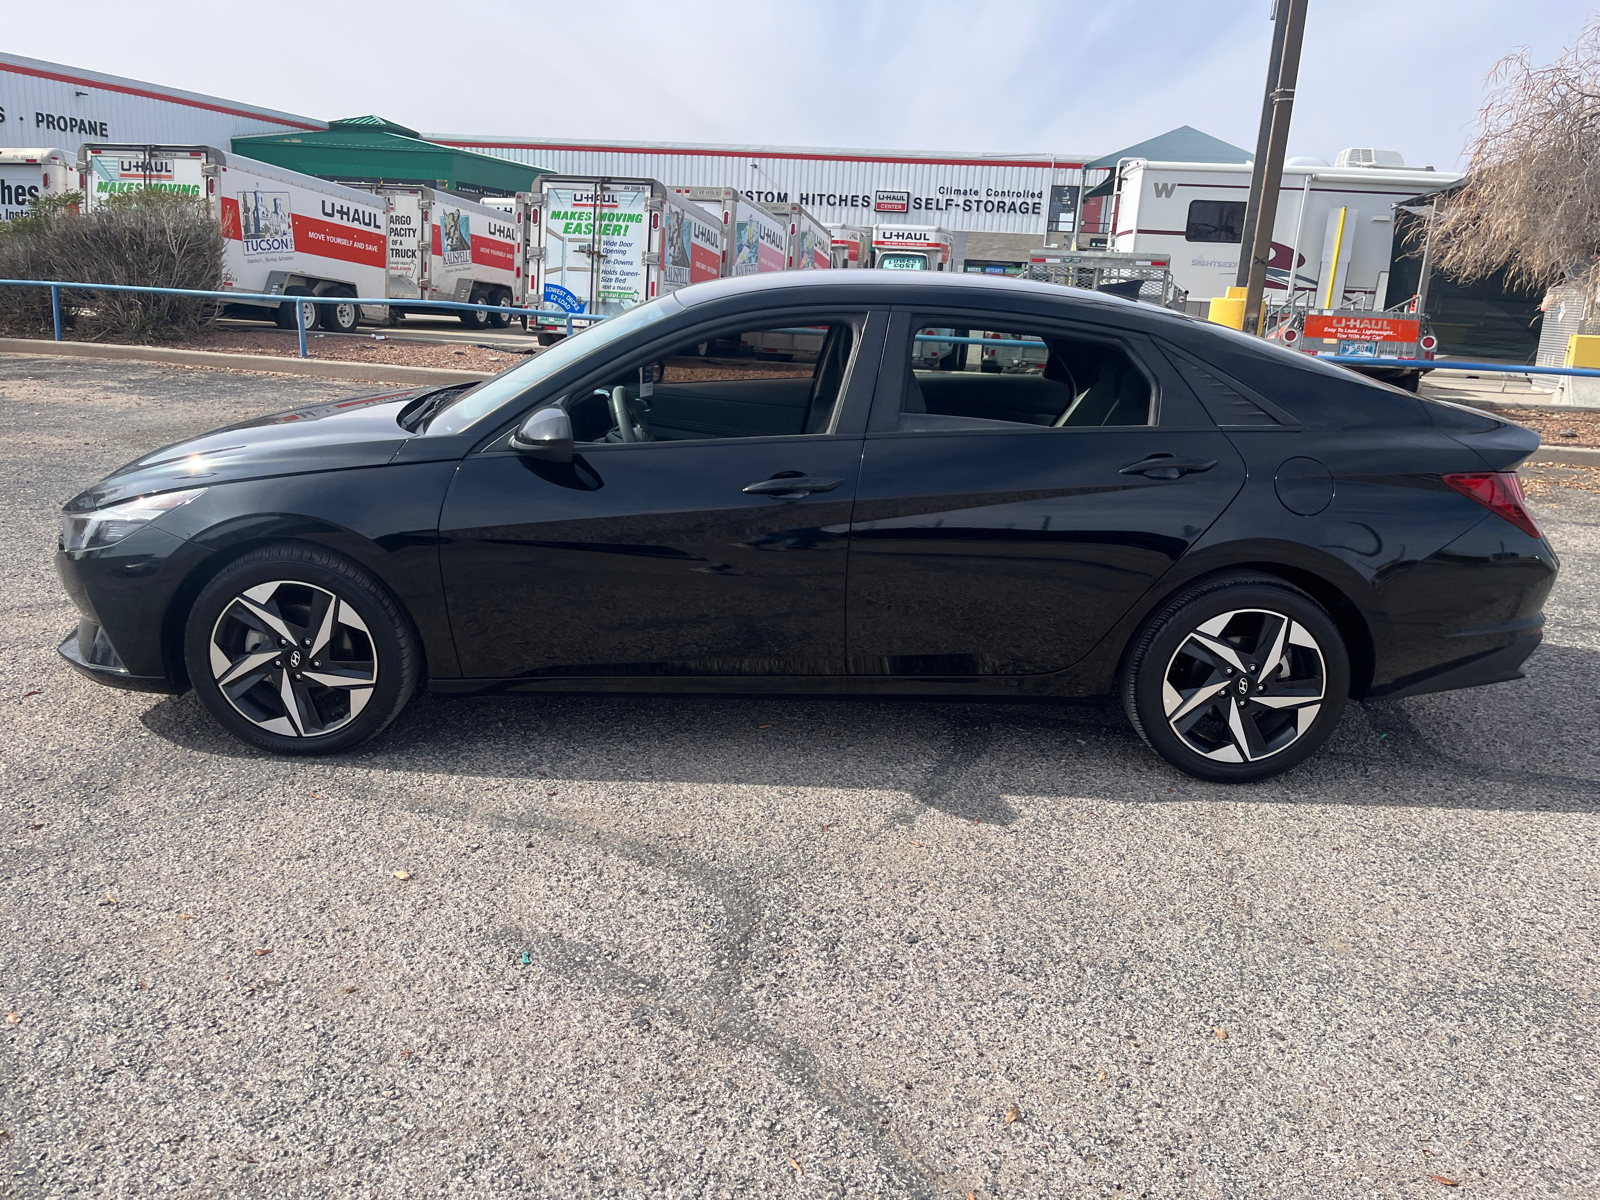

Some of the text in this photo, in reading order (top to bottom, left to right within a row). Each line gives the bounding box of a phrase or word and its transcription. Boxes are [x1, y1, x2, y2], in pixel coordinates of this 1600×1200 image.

[35, 111, 108, 138] PROPANE
[121, 160, 172, 173] U-HAUL
[96, 181, 143, 193] MAKES
[938, 186, 1043, 199] Climate Controlled
[573, 193, 618, 203] U-HAUL
[740, 190, 871, 208] STOM HITCHES
[878, 194, 905, 202] U-HAUL
[912, 197, 1042, 215] SELF-STORAGE
[321, 199, 381, 230] U-HAUL
[550, 210, 643, 223] MAKES MOVING
[563, 222, 629, 236] EASIER!
[693, 221, 718, 249] U-HAUL
[308, 231, 378, 253] MOVE YOURSELF AND SAVE
[760, 223, 784, 251] U-HAUL
[882, 231, 930, 241] U-HAUL
[244, 238, 288, 252] TUCSON
[619, 240, 633, 248] Door
[390, 248, 417, 259] TRUCK
[602, 247, 627, 256] Opening
[602, 258, 633, 266] Tie-Downs
[614, 276, 626, 284] Bed
[545, 286, 580, 311] LOWEST DECKS
[600, 291, 635, 299] uhaul.com
[550, 294, 571, 310] EZ-LOAD
[1332, 318, 1391, 330] U-HAUL
